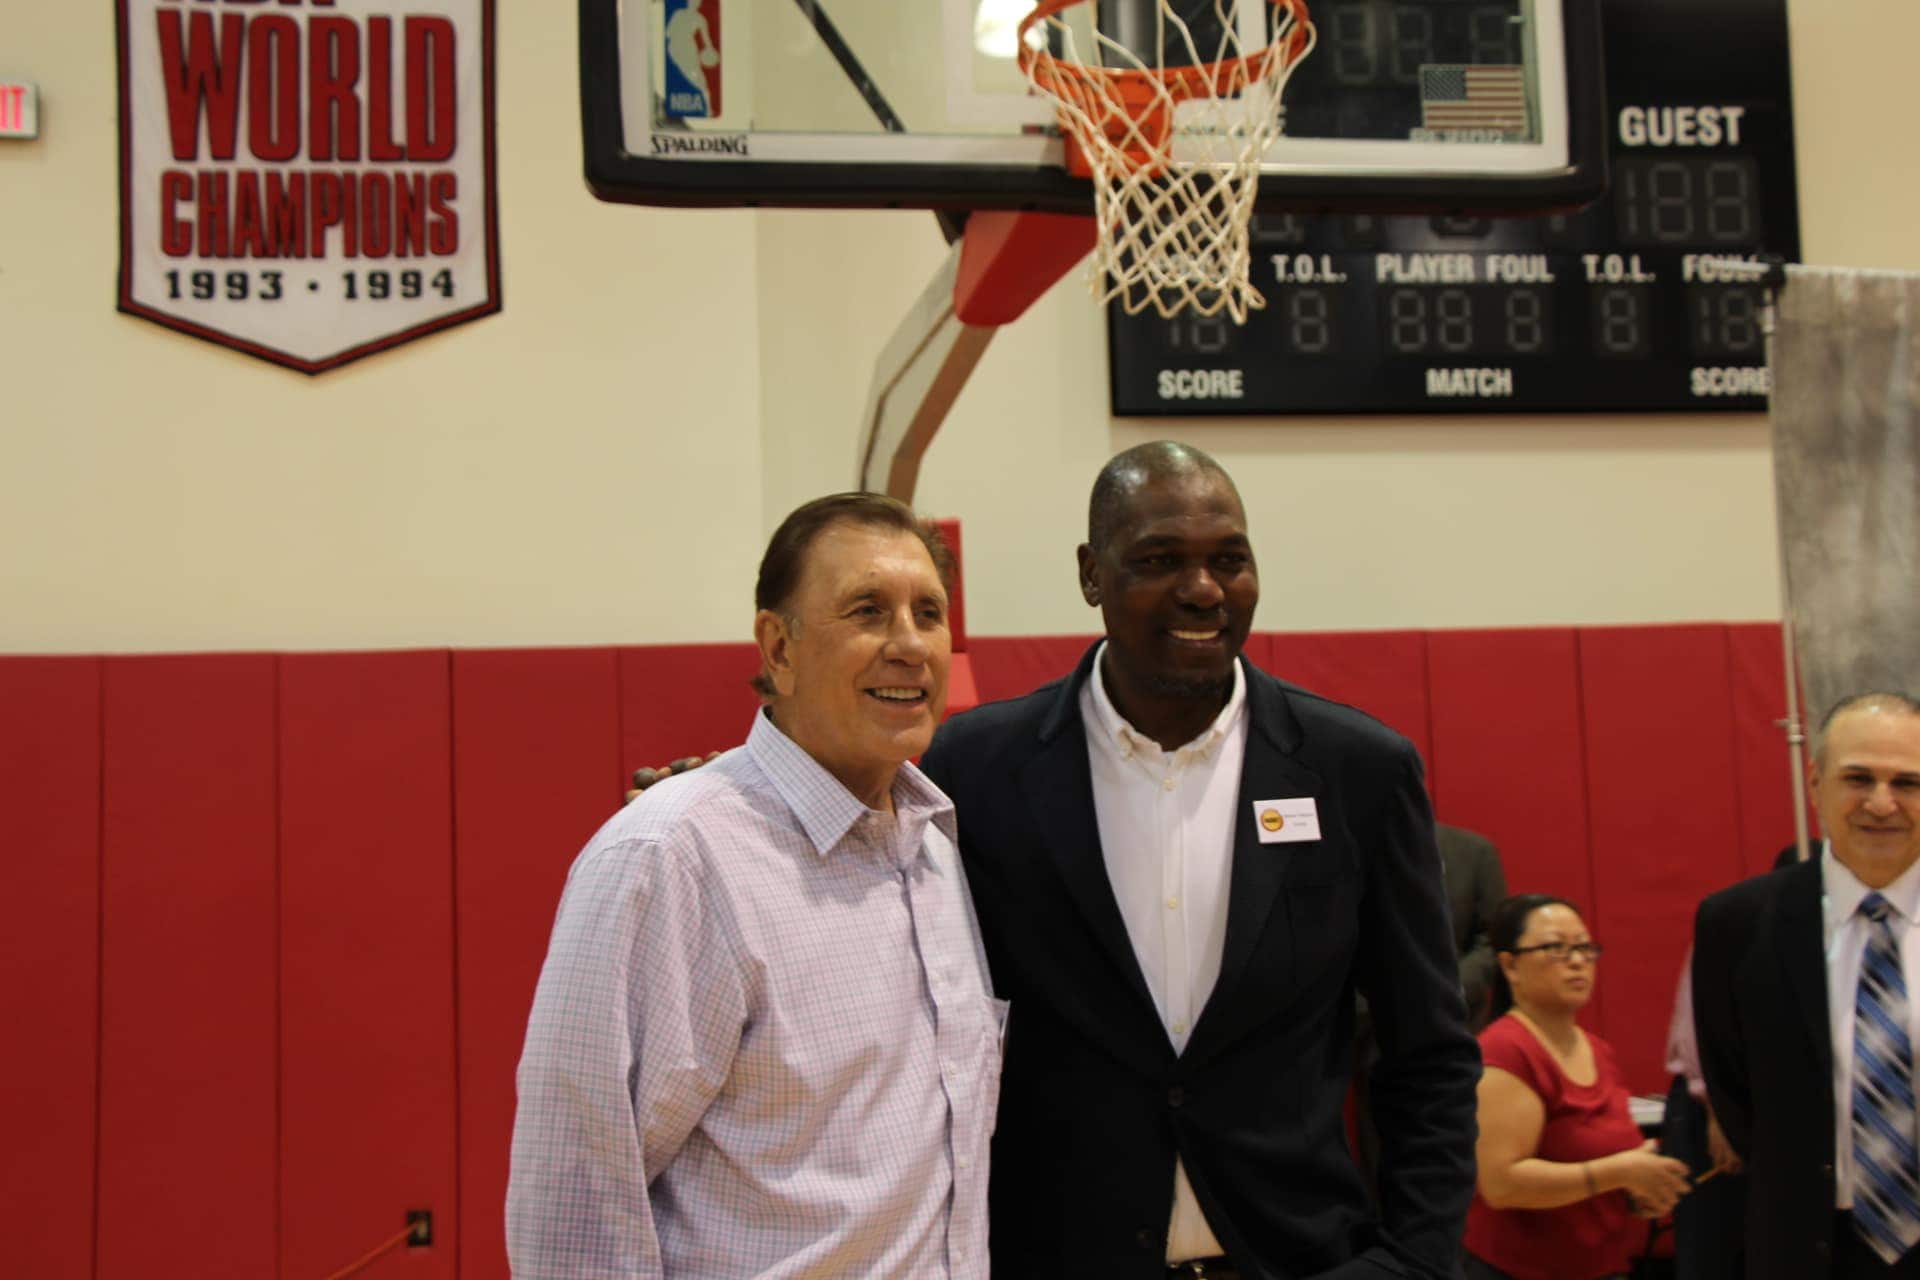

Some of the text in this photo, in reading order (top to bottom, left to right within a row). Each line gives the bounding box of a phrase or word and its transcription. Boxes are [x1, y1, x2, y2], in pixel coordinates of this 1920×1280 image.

[155, 9, 457, 162] WORLD
[670, 92, 703, 112] NBA
[1618, 105, 1745, 146] GUEST
[651, 134, 748, 155] SPALDING
[160, 170, 459, 258] CHAMPIONS
[1271, 254, 1347, 283] T.O.L.
[1376, 253, 1555, 283] PLAYER FOUL
[1582, 254, 1656, 283] T.O.L.
[165, 269, 456, 301] 1993 1994
[1158, 369, 1244, 399] SCORE
[1426, 367, 1513, 397] MATCH
[1691, 366, 1771, 396] SCORE
